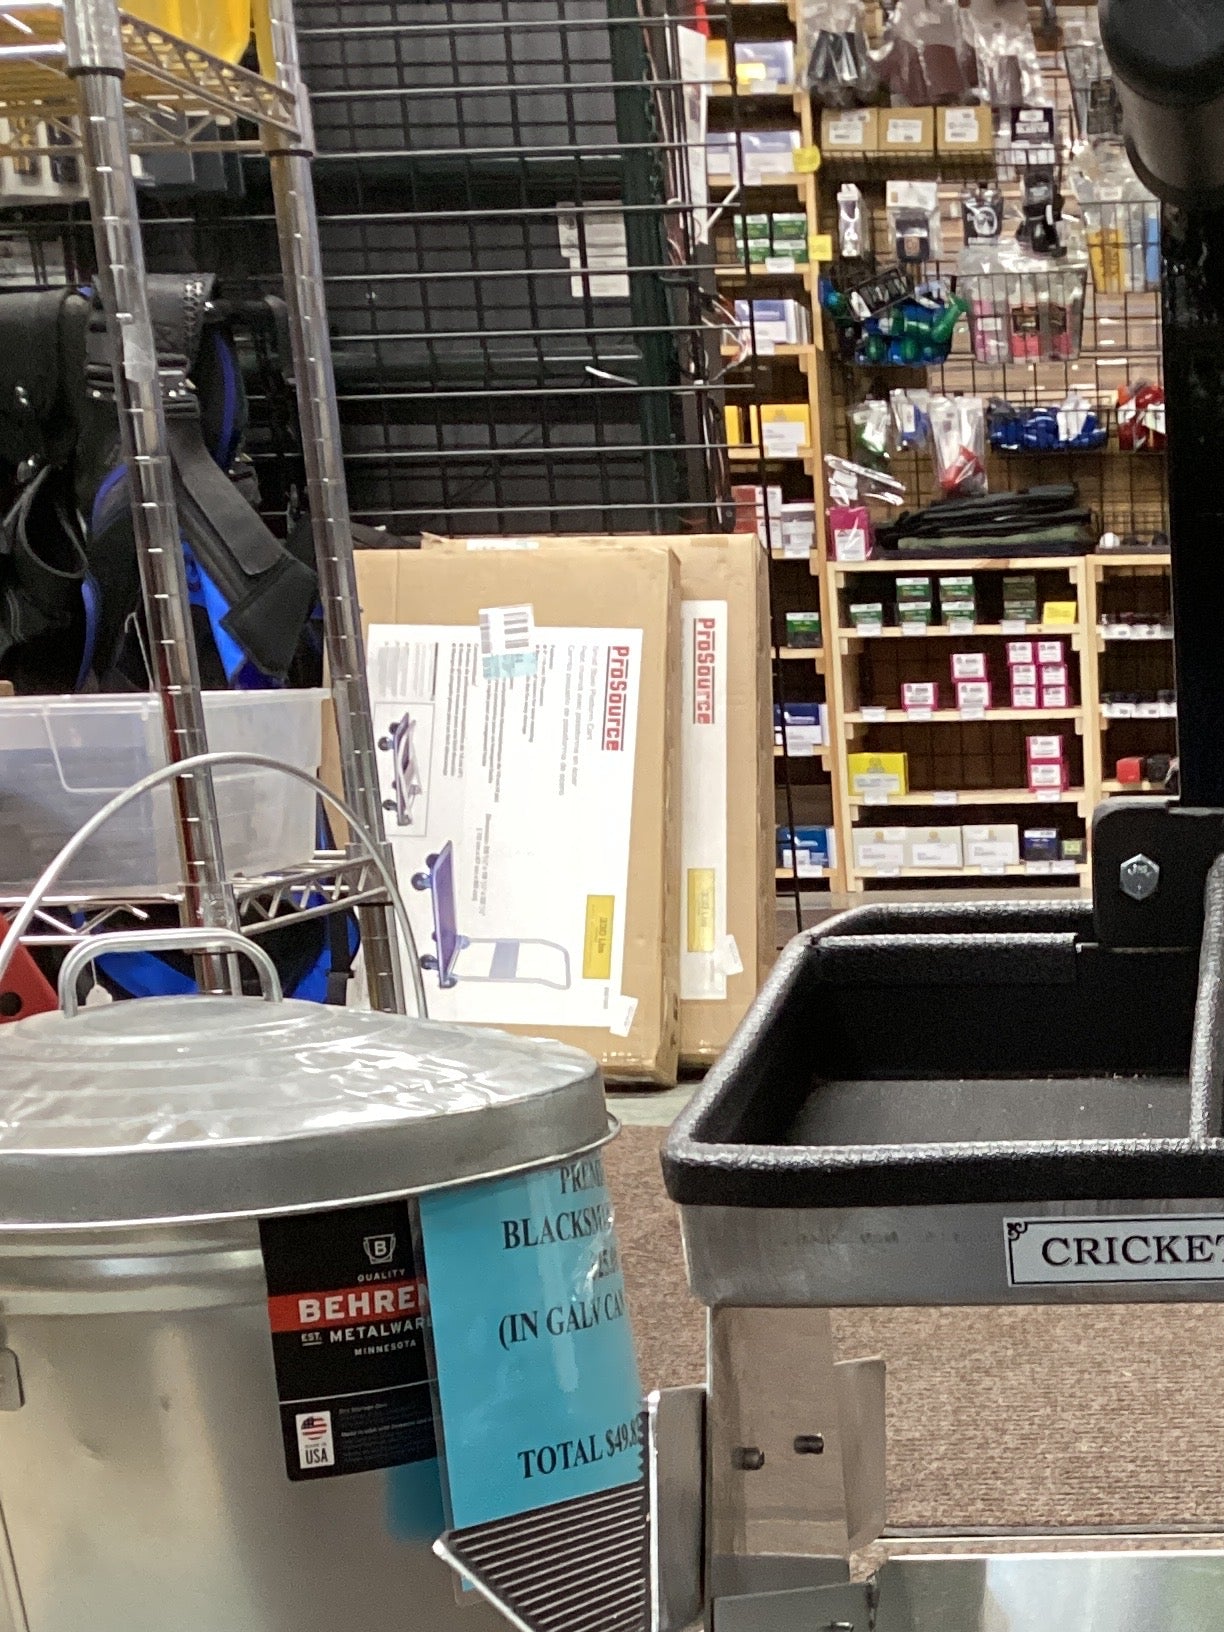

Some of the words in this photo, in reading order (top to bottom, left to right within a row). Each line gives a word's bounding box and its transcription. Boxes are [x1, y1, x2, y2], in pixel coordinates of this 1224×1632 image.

[695, 618, 716, 724] ProSource
[604, 645, 630, 751] ProSource
[374, 1240, 387, 1256] B
[501, 1204, 611, 1250] BLACKSM
[357, 1268, 406, 1283] QUALITY
[498, 1310, 539, 1351] (IN
[546, 1296, 601, 1336] GALV
[354, 1338, 417, 1357] MINNESOTA
[305, 1447, 329, 1465] USA
[517, 1434, 603, 1479] TOTAL
